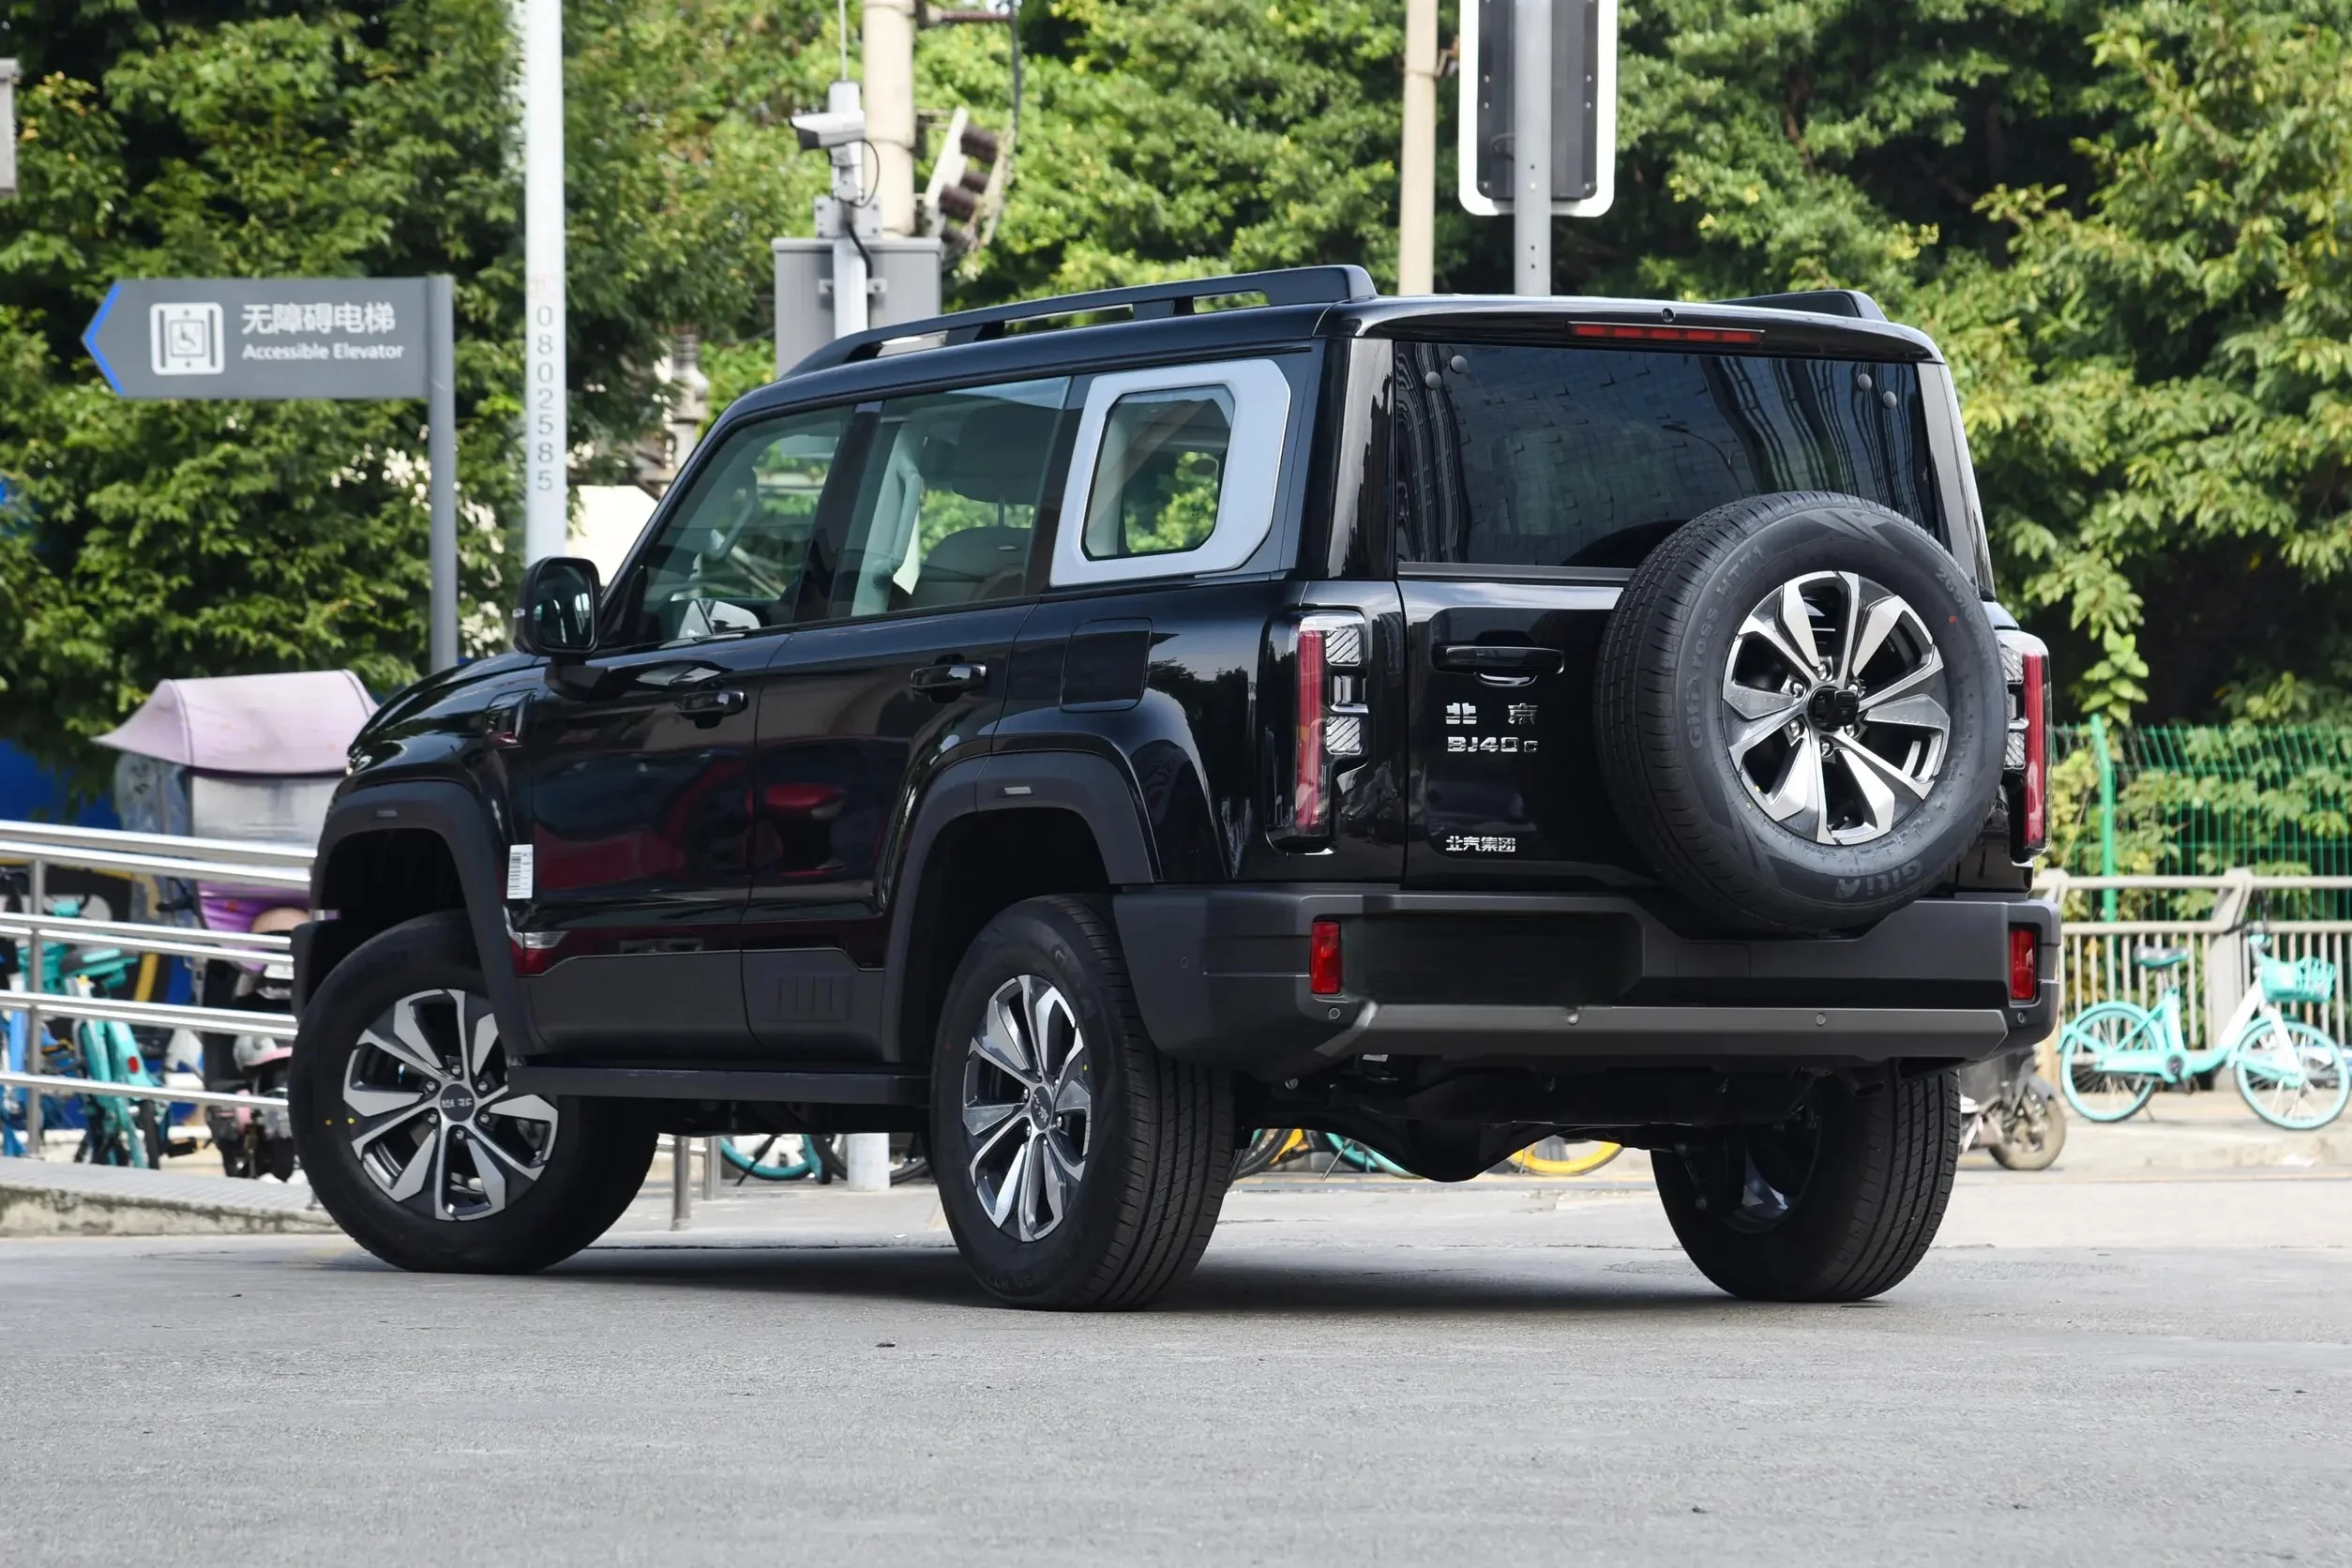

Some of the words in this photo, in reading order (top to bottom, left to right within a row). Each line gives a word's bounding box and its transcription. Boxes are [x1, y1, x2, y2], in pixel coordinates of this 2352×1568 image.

[241, 302, 396, 335] 无障碍电梯
[241, 342, 330, 360] Accessible
[333, 342, 404, 360] Elevator
[536, 305, 554, 491] 0802585
[1445, 836, 1516, 852] 北汽集团
